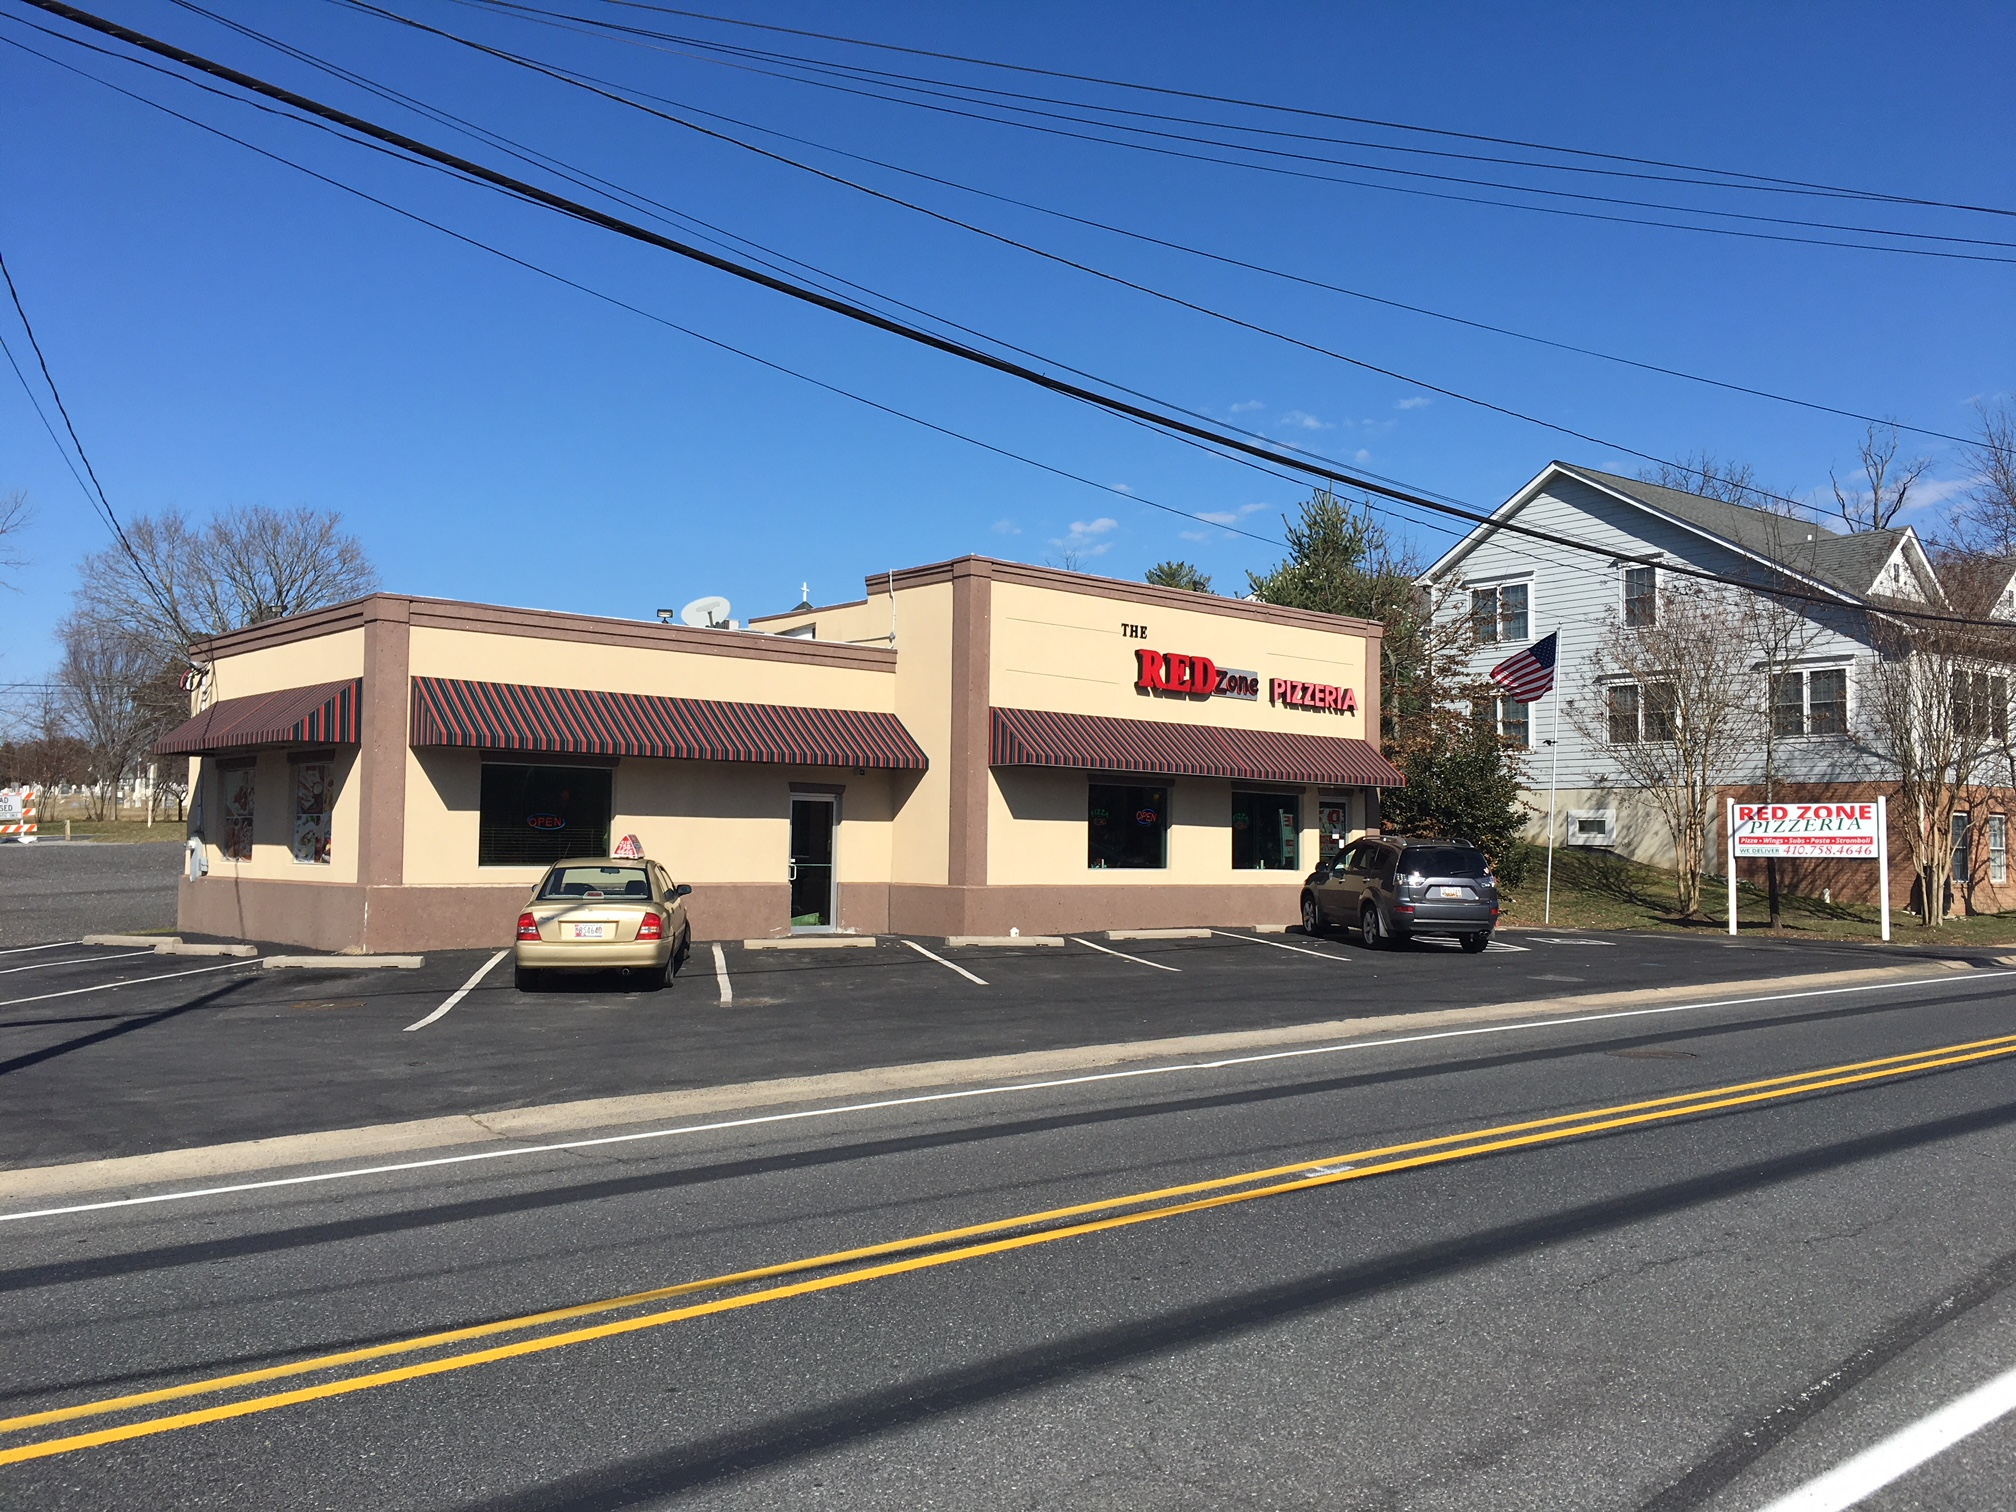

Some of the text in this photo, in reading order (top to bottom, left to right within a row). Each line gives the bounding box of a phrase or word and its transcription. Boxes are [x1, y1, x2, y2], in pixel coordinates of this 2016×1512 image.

[1121, 623, 1148, 639] THE
[1136, 649, 1358, 714] RED Zone PIZZERIA
[1136, 810, 1157, 822] OPEN
[1739, 805, 1872, 821] RED ZONE
[528, 817, 563, 827] OPEN
[1750, 816, 1862, 834] PIZZERIA
[1763, 837, 1784, 845] Wings
[1783, 845, 1872, 855] 410.758.4646
